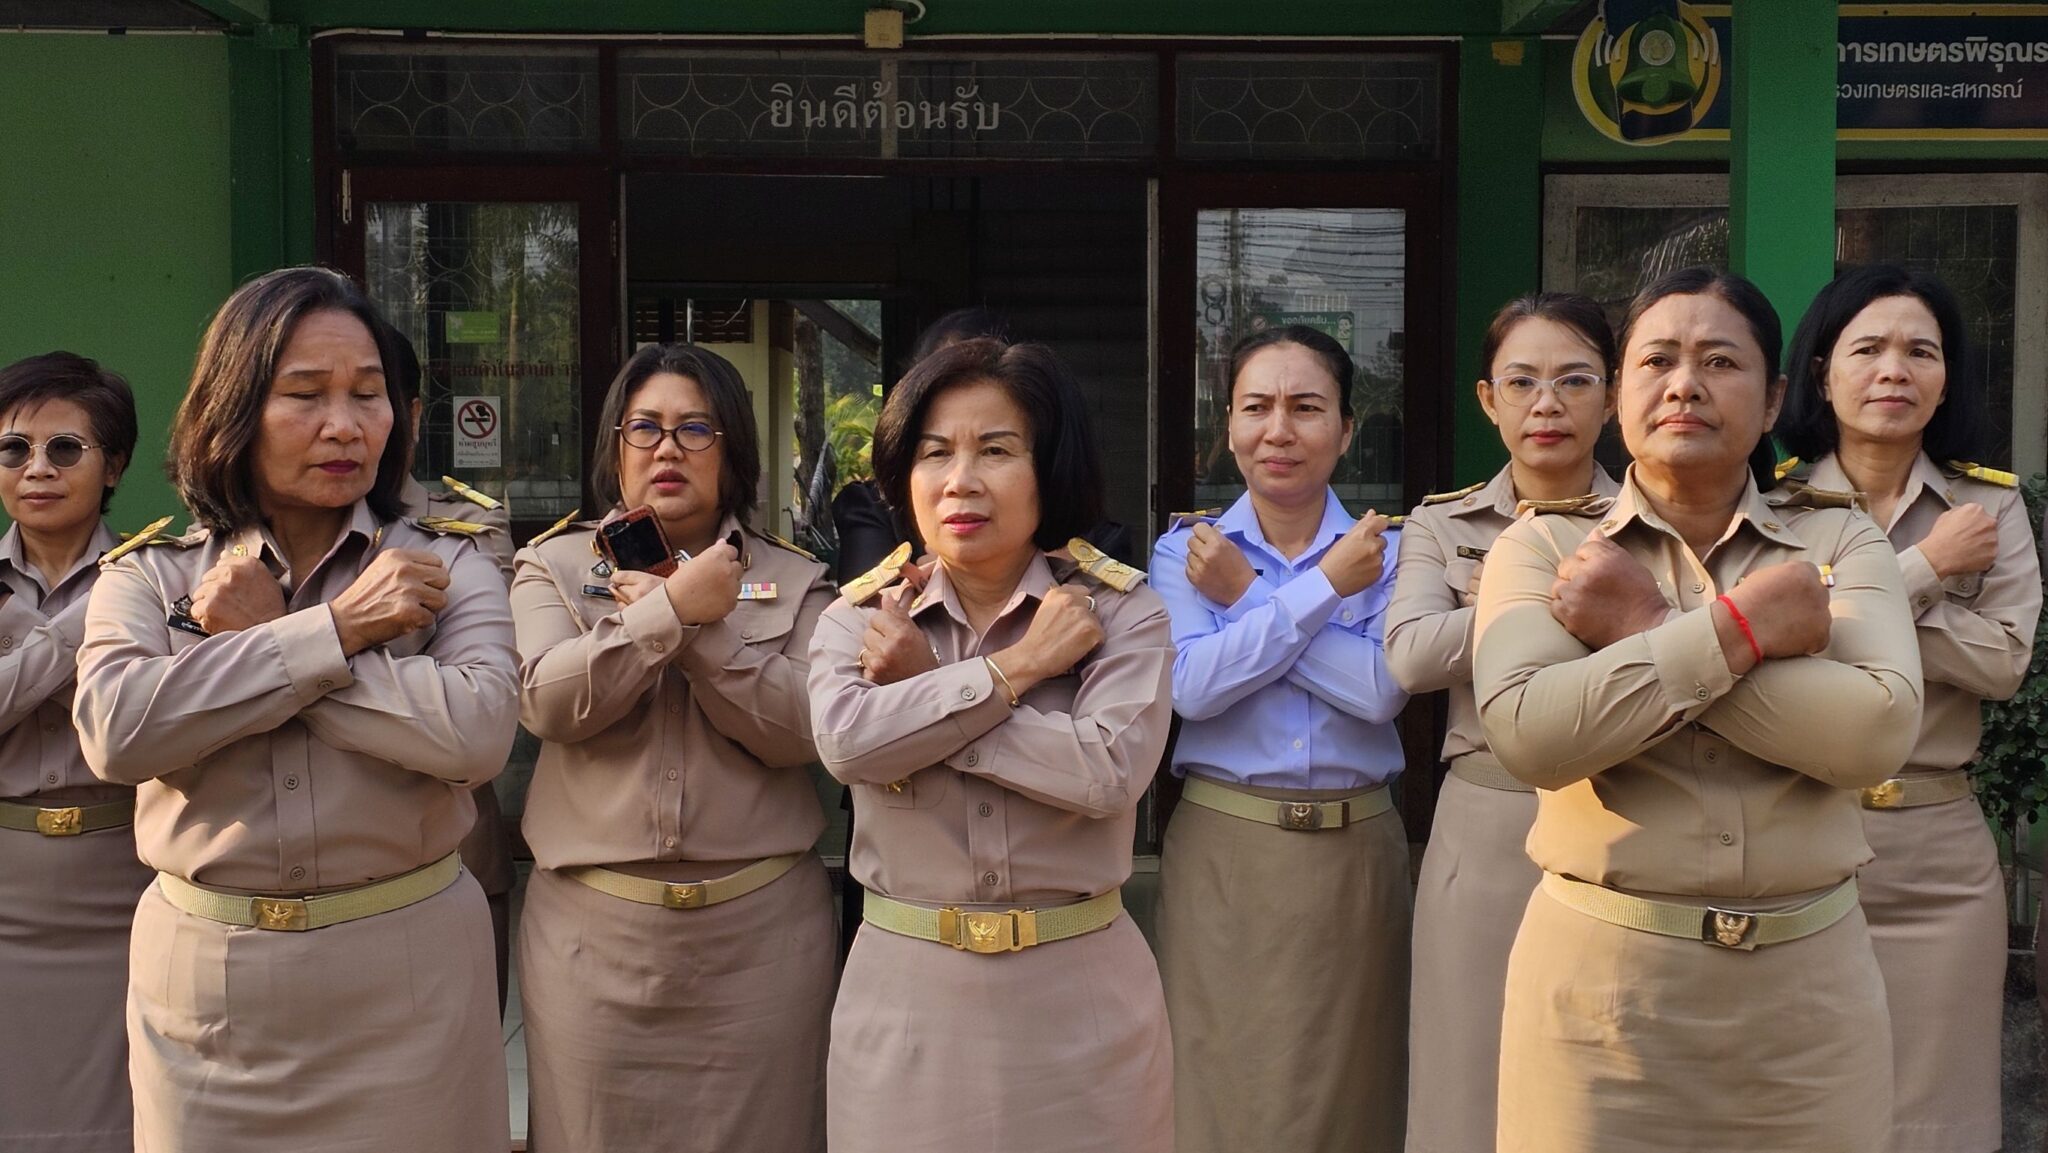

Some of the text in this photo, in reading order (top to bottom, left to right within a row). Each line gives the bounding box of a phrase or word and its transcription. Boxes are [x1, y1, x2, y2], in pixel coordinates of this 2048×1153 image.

[770, 81, 1000, 130] ยินดีต้อนรับ
